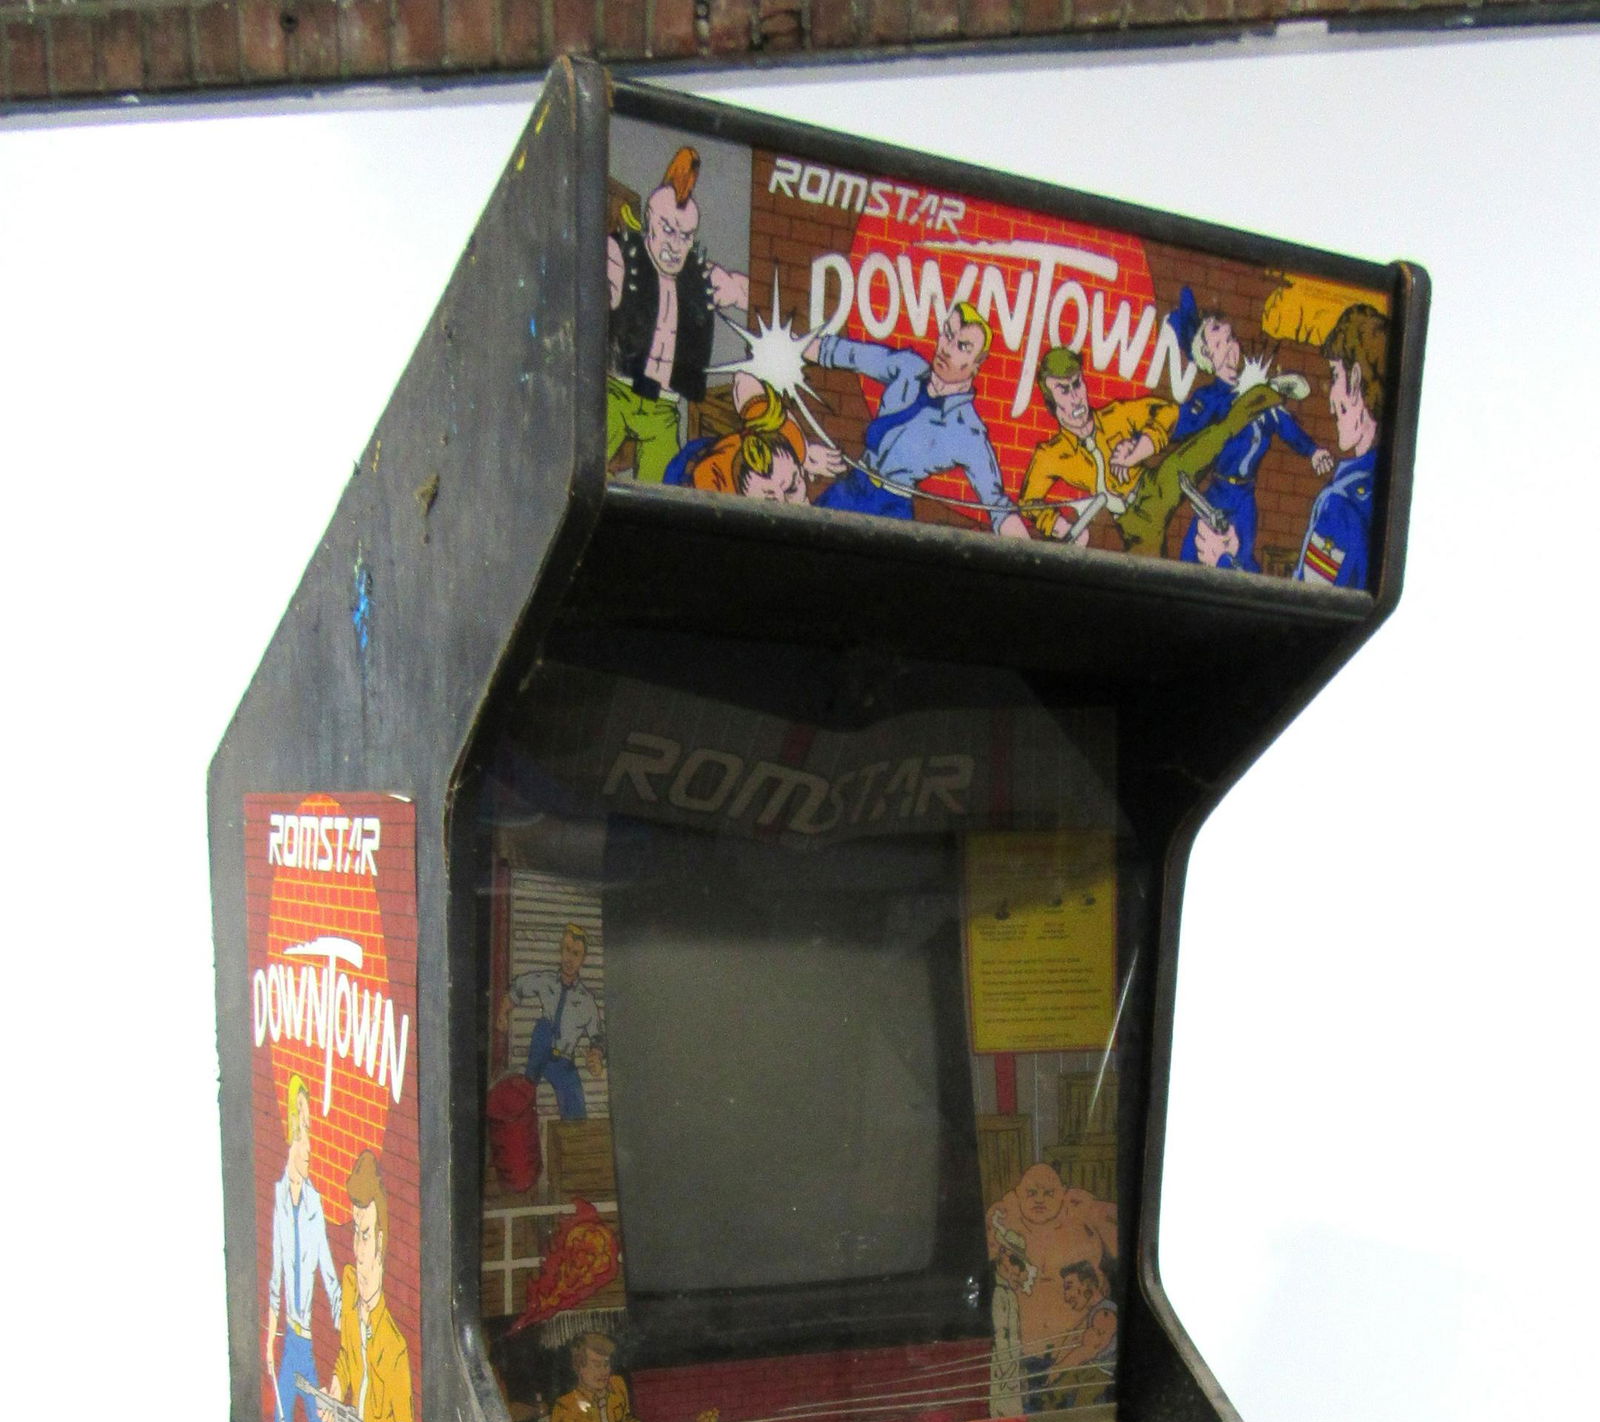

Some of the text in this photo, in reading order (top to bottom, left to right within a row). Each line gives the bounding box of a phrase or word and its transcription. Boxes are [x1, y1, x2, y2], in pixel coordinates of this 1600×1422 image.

[768, 158, 967, 236] ROMSTAR
[809, 240, 1200, 418] DOWNTOWN
[602, 731, 977, 835] ROMSTAR
[268, 813, 382, 877] ROMSTAR
[253, 935, 410, 1117] DOWNTOWN
